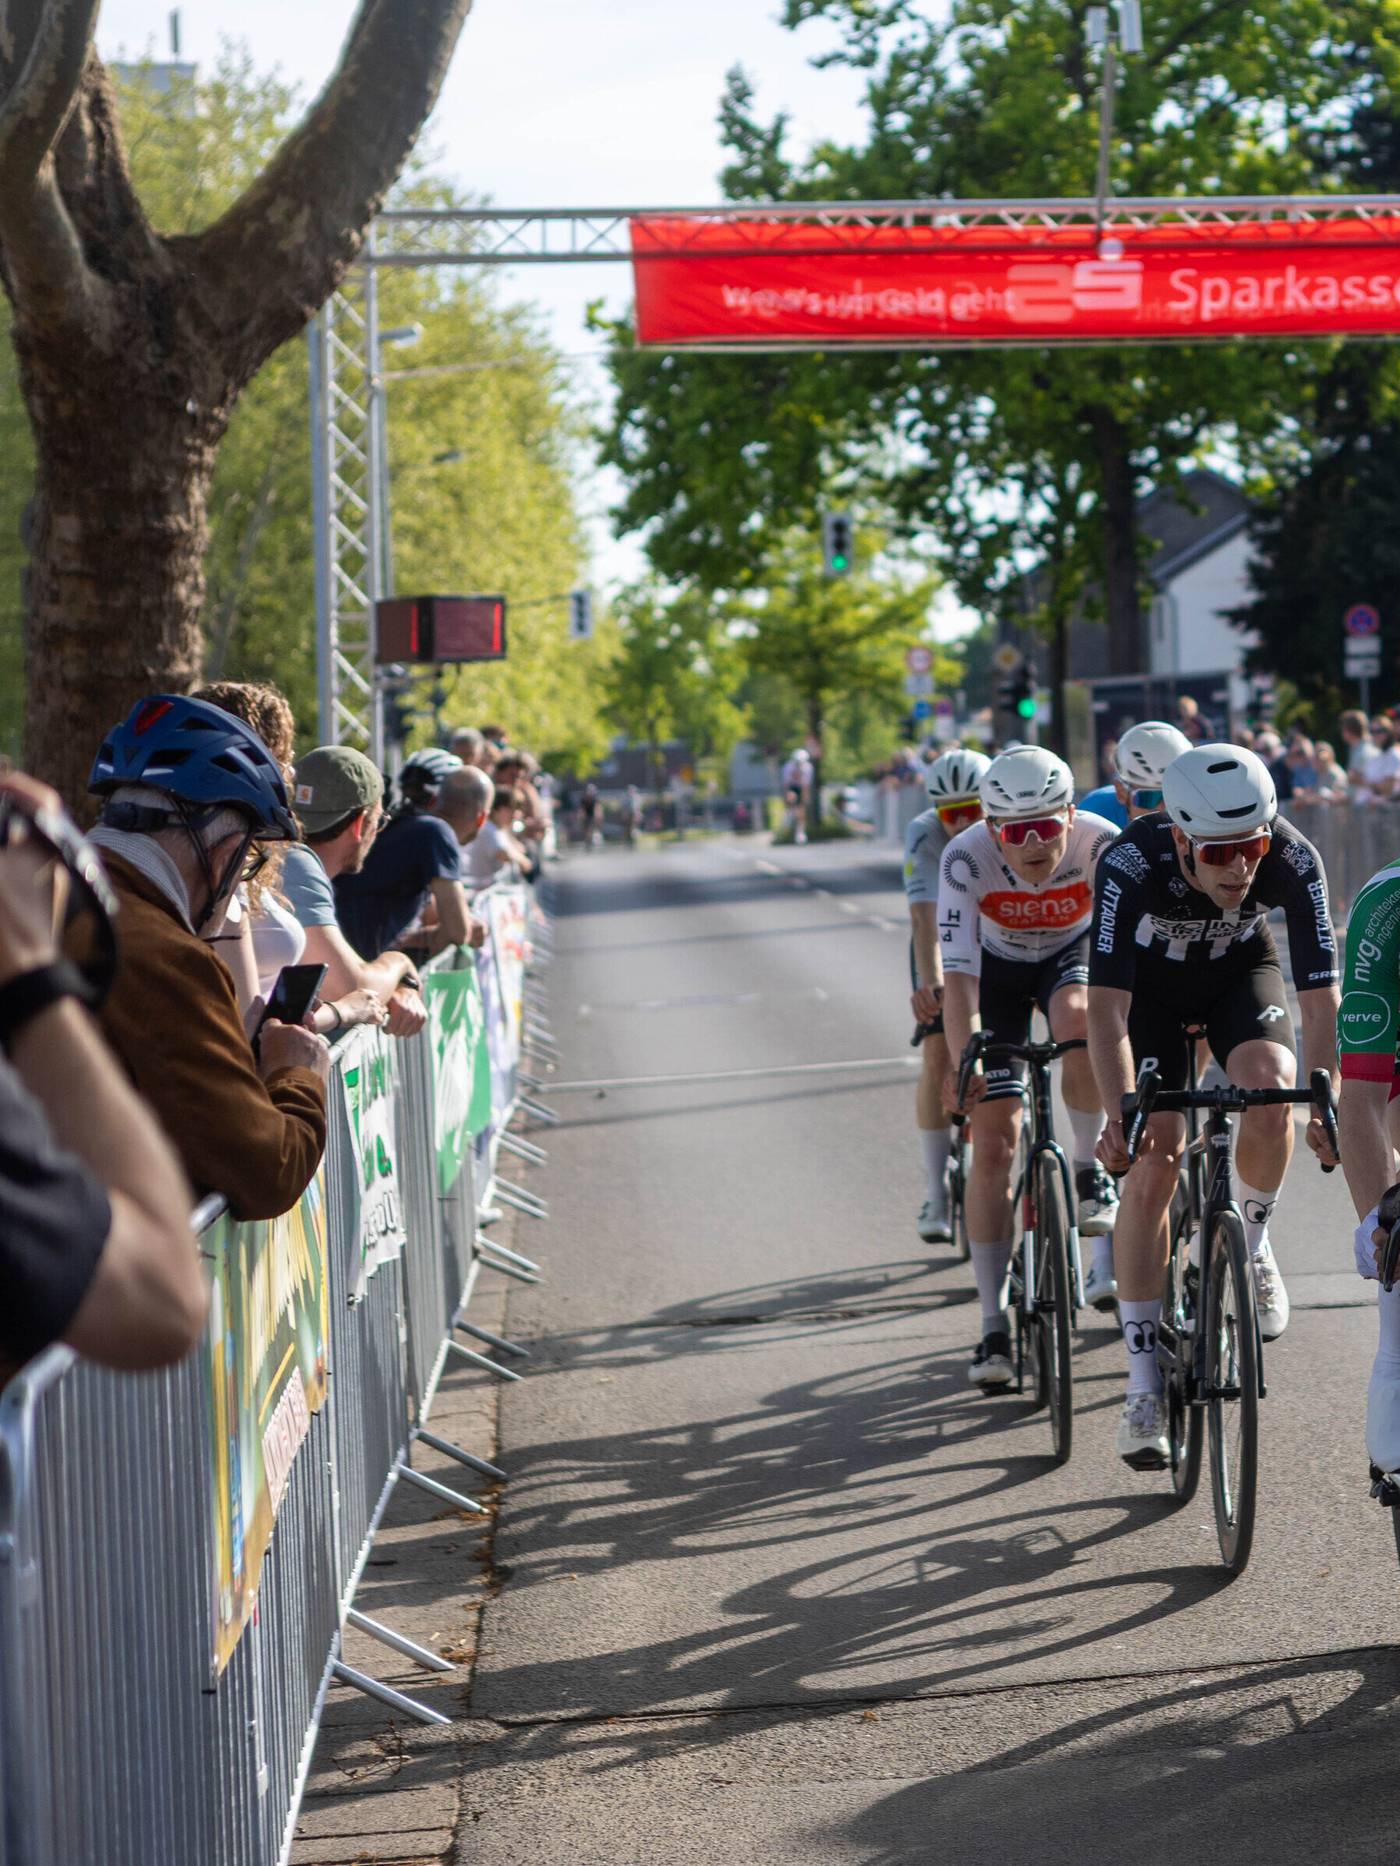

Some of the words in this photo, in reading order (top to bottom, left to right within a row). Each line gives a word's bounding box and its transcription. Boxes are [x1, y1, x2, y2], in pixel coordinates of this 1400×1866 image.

[999, 896, 1078, 918] siena
[1097, 877, 1122, 954] ATTAQUER
[1307, 879, 1335, 953] ATTAQUER
[1354, 938, 1382, 983] nvg
[1343, 1012, 1382, 1023] verve
